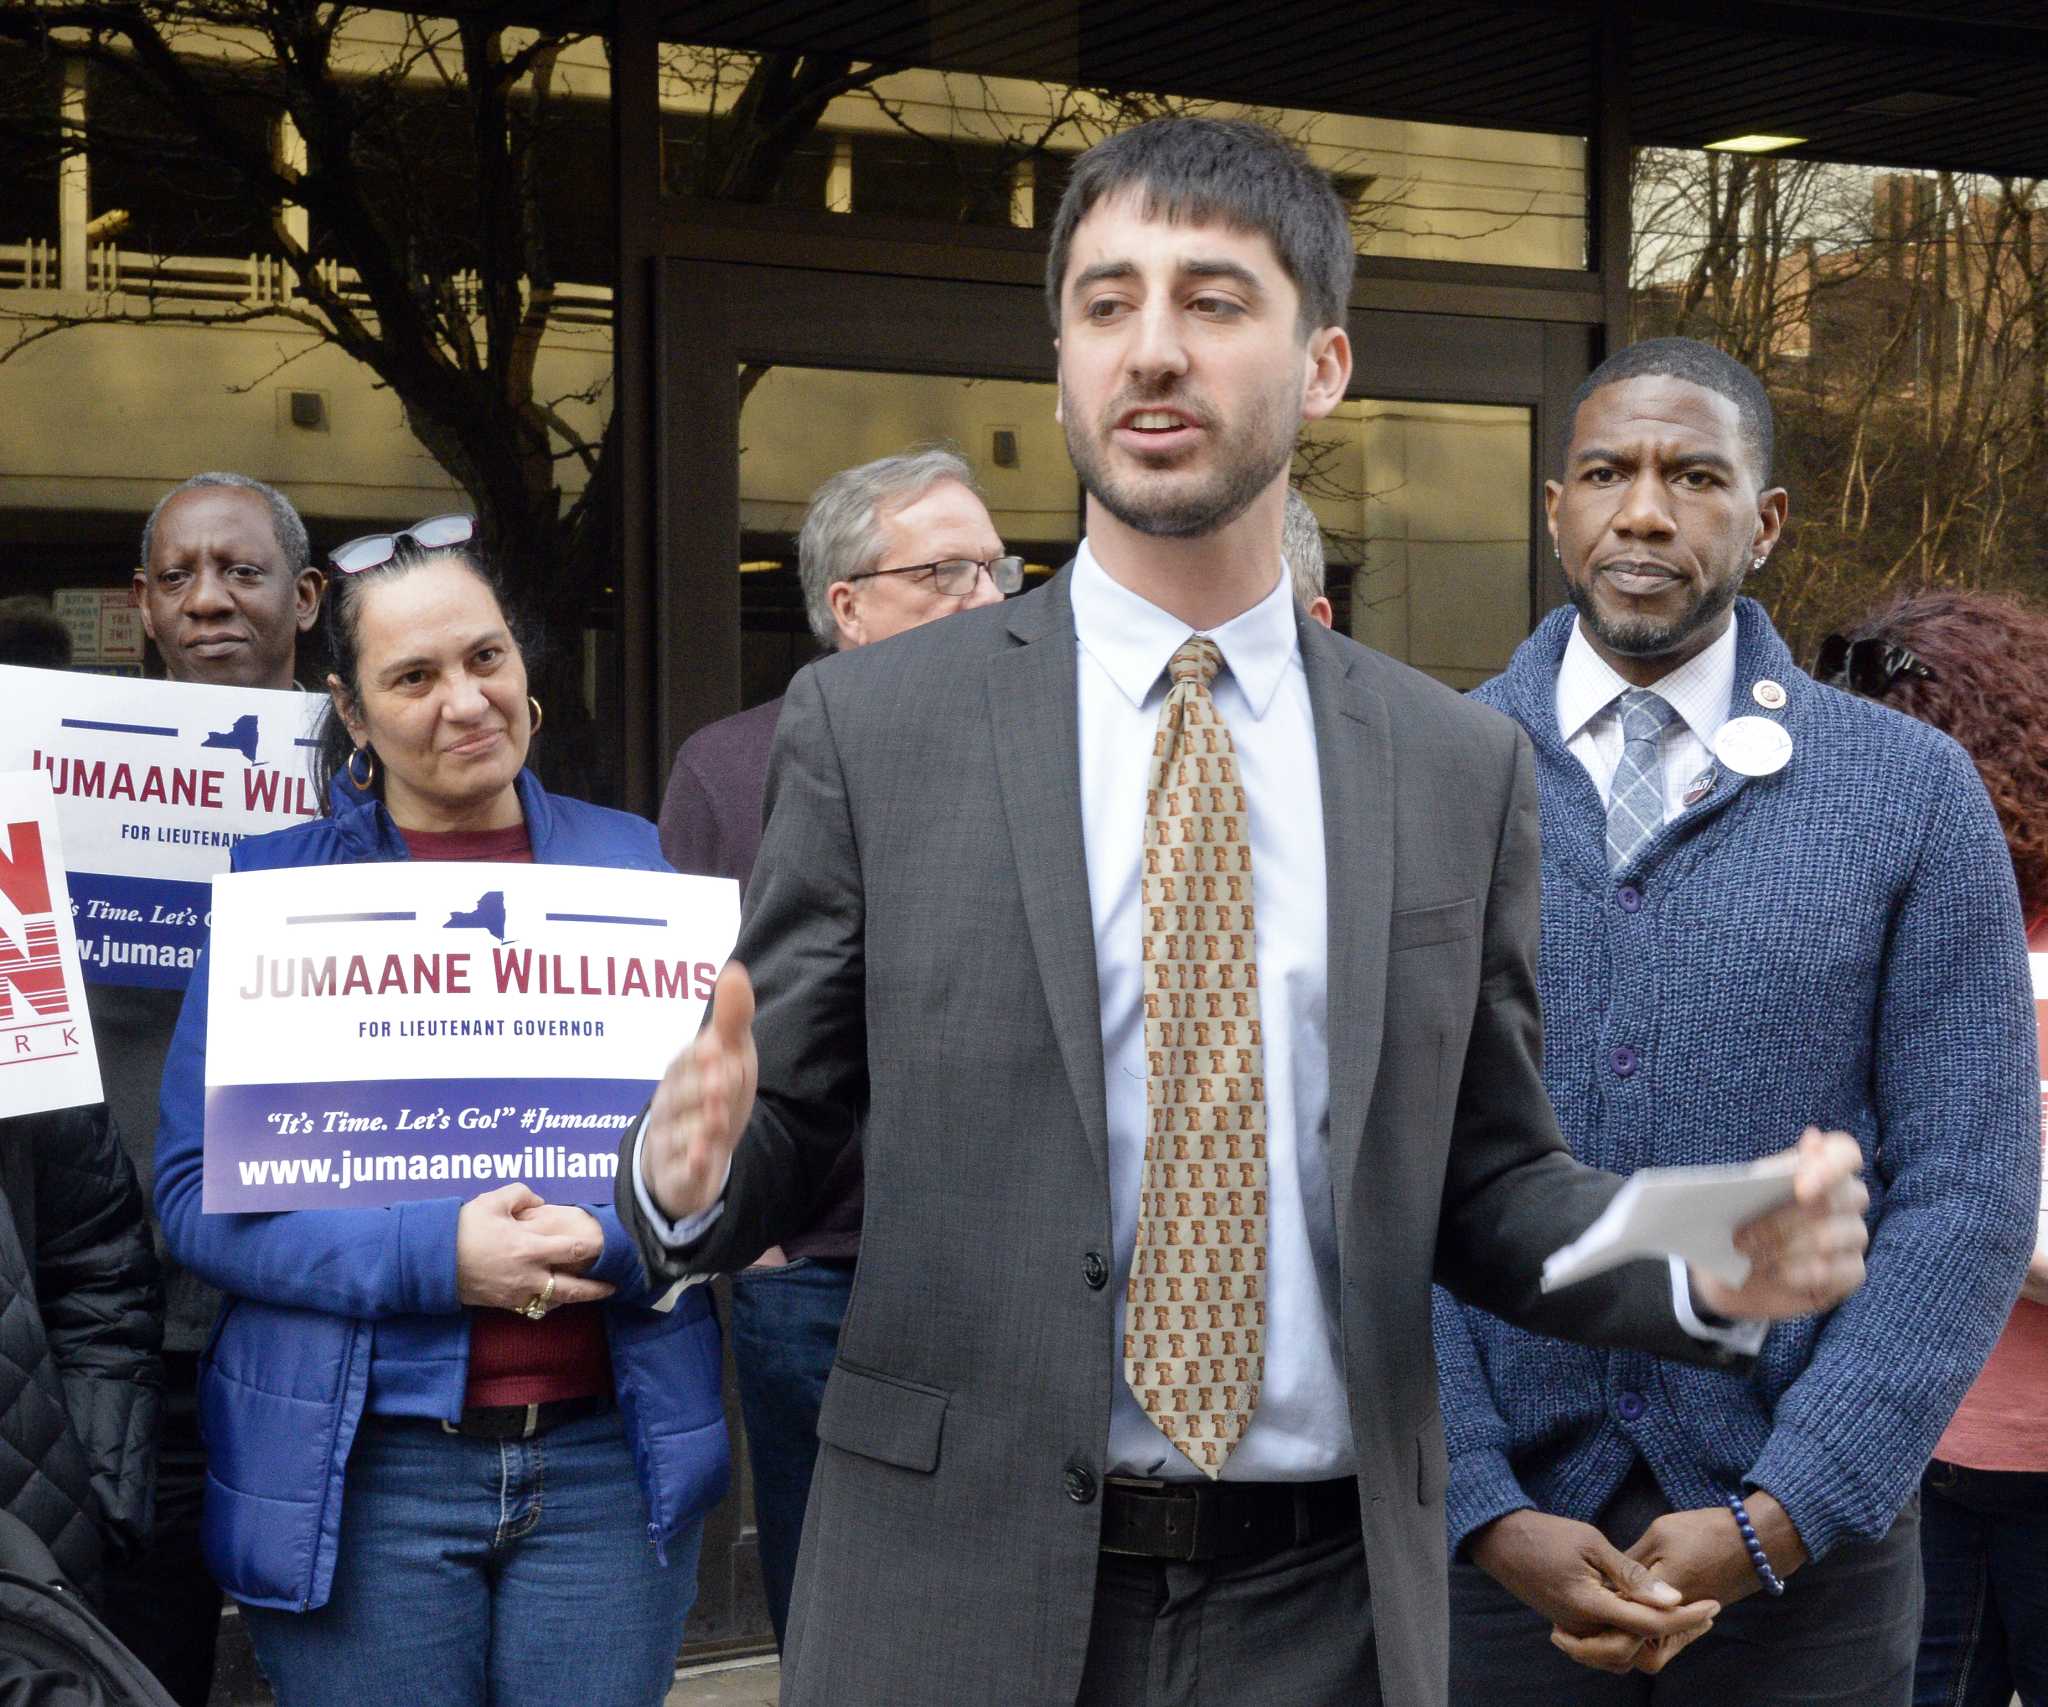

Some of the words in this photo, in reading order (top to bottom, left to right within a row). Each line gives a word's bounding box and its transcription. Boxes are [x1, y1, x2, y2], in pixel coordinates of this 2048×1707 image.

[121, 824, 150, 840] FOR
[86, 899, 143, 922] Time.
[149, 905, 198, 927] Let’s
[239, 952, 471, 1001] JUMAANE
[493, 947, 717, 1001] WILLIAMS
[358, 1020, 392, 1038] FOR
[399, 1019, 506, 1037] LIEUTENANT
[513, 1019, 605, 1038] GOVERNOR
[266, 1111, 315, 1136] “It’s
[321, 1110, 389, 1134] Time.
[395, 1106, 450, 1132] Let’s
[457, 1105, 516, 1131] Go!”
[238, 1146, 618, 1190] www.jumaanewilliam
